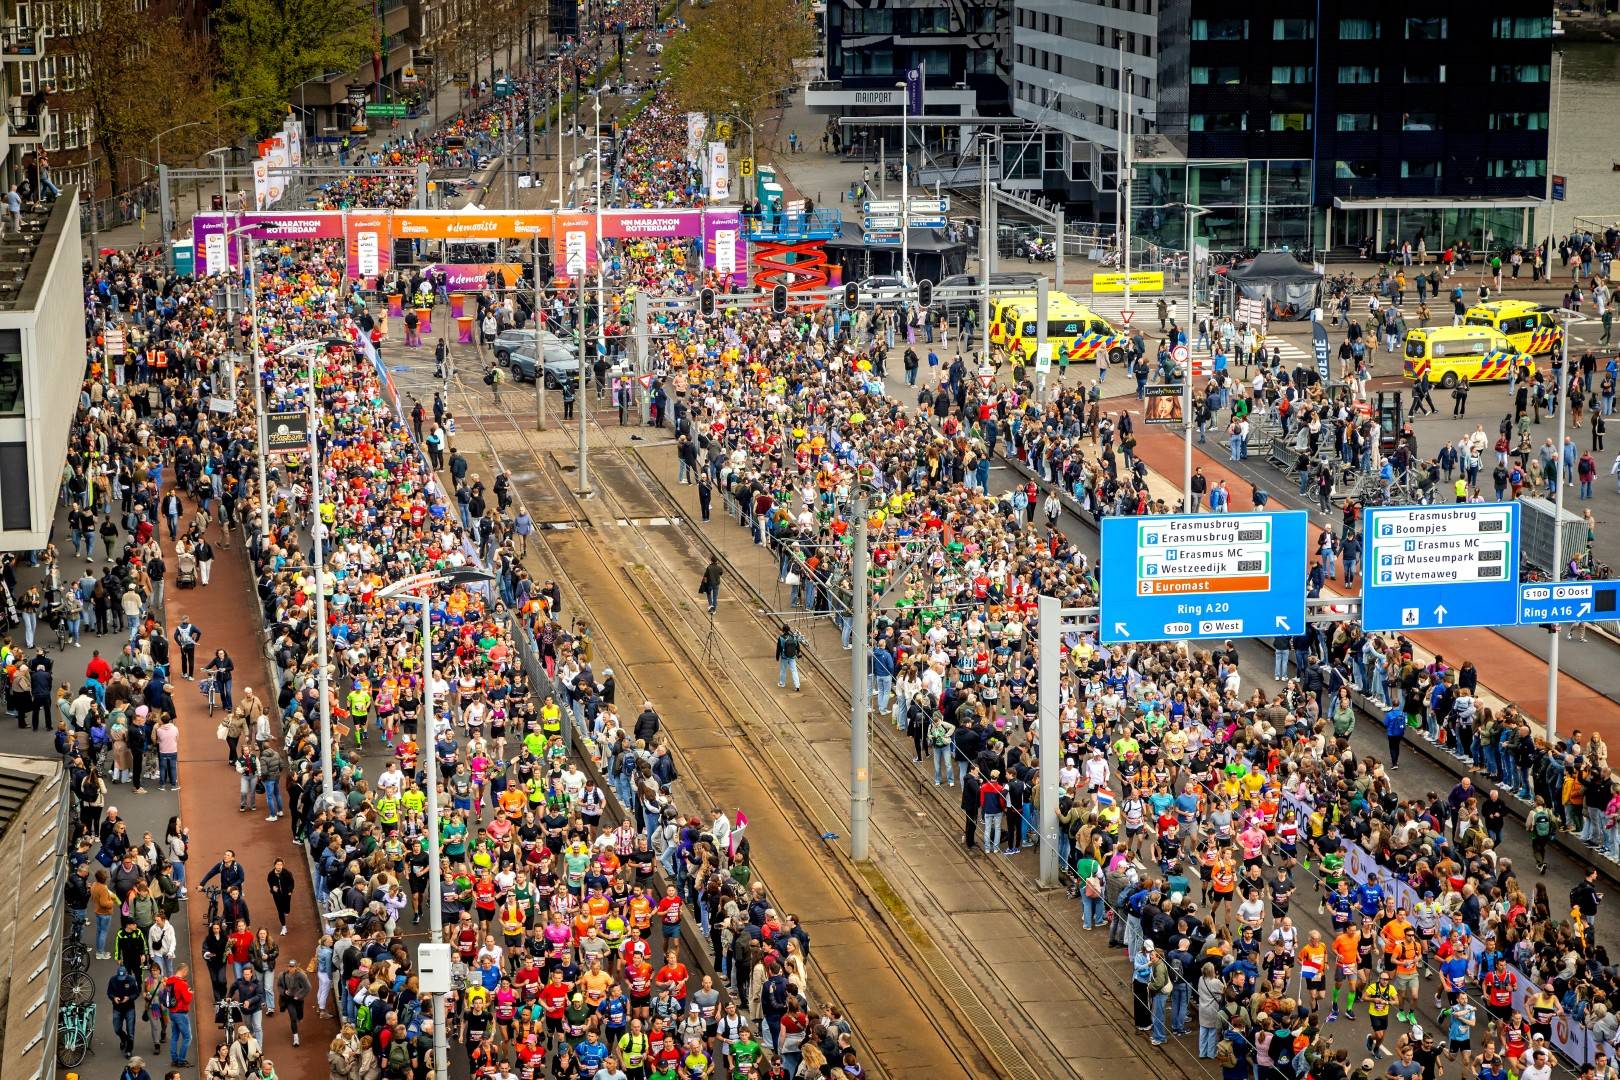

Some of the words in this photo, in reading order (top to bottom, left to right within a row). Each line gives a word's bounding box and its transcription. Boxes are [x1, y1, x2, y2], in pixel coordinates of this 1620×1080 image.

[855, 92, 892, 102] MAINPORT
[743, 161, 750, 174] B
[638, 218, 680, 226] MARATHON
[1409, 510, 1476, 521] Erasmusbrug
[1170, 520, 1240, 530] Erasmusbrug
[1396, 524, 1447, 534] Boompjes
[1162, 532, 1234, 543] Erasmusbrug
[1418, 540, 1460, 549] Erasmus
[1464, 539, 1480, 548] MC
[1180, 550, 1224, 559] Erasmus
[1227, 549, 1243, 557] MC
[1407, 553, 1474, 564] Museumpark
[1161, 564, 1227, 574] Westzeedijk
[1395, 570, 1457, 580] Wytemaweg
[1156, 581, 1210, 592] Euromast
[1568, 587, 1589, 596] Oost
[1178, 604, 1202, 615] Ring
[1206, 603, 1229, 612] A20
[1524, 607, 1547, 618] Ring
